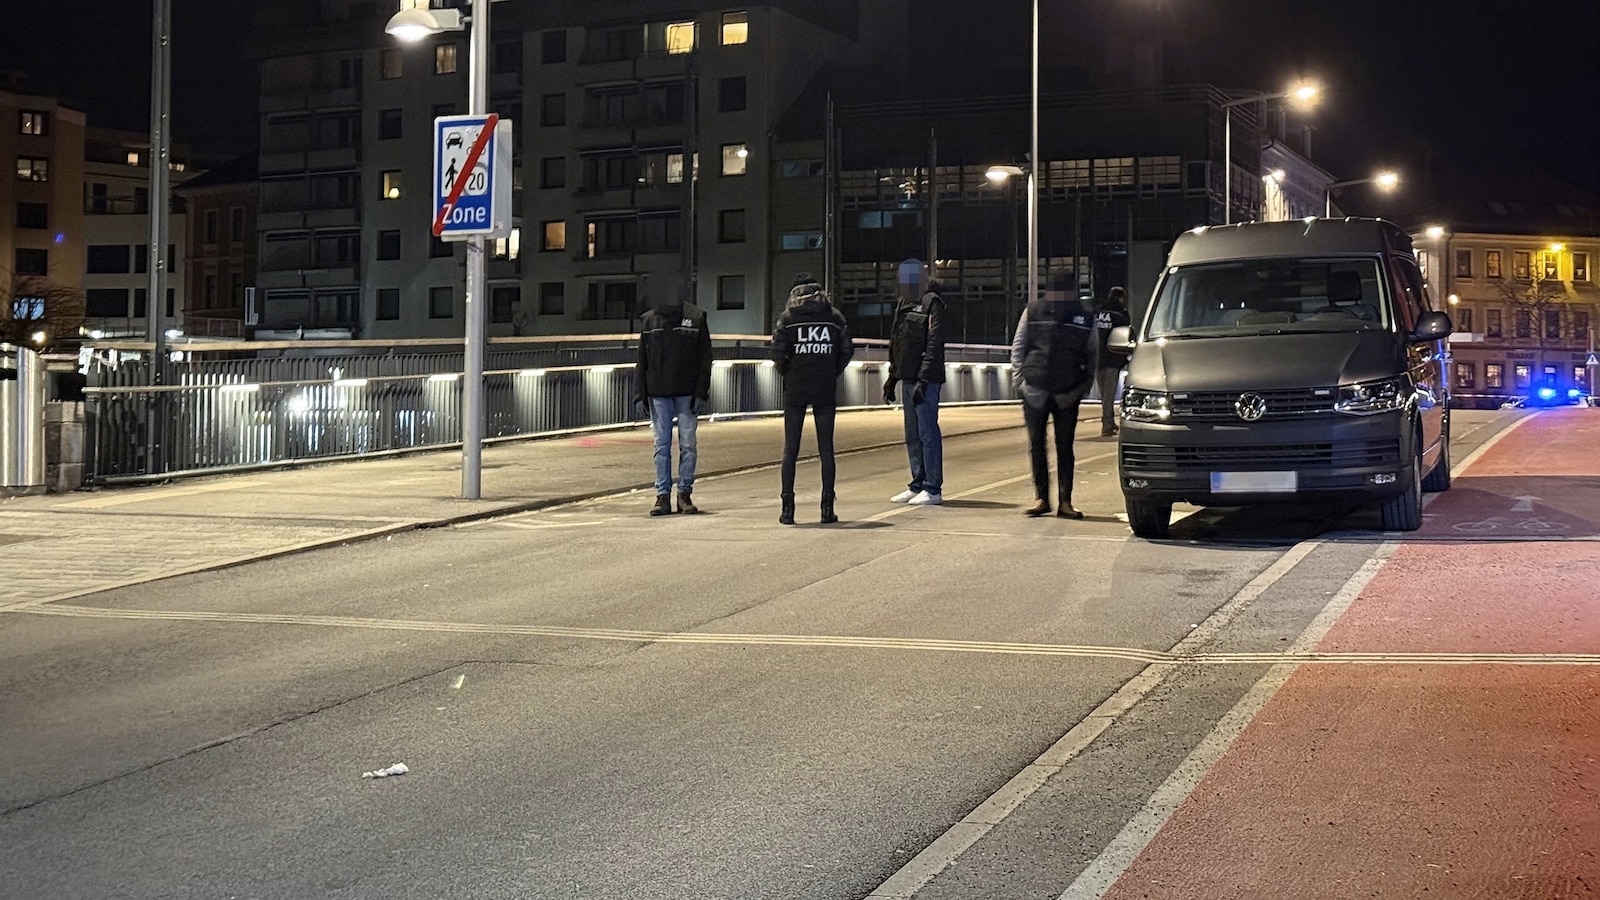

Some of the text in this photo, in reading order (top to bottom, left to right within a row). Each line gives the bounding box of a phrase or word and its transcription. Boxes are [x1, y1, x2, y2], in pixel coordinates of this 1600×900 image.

[468, 172, 484, 190] 20
[442, 203, 486, 224] Zone
[797, 326, 831, 342] LKA
[793, 343, 834, 354] TATORT
